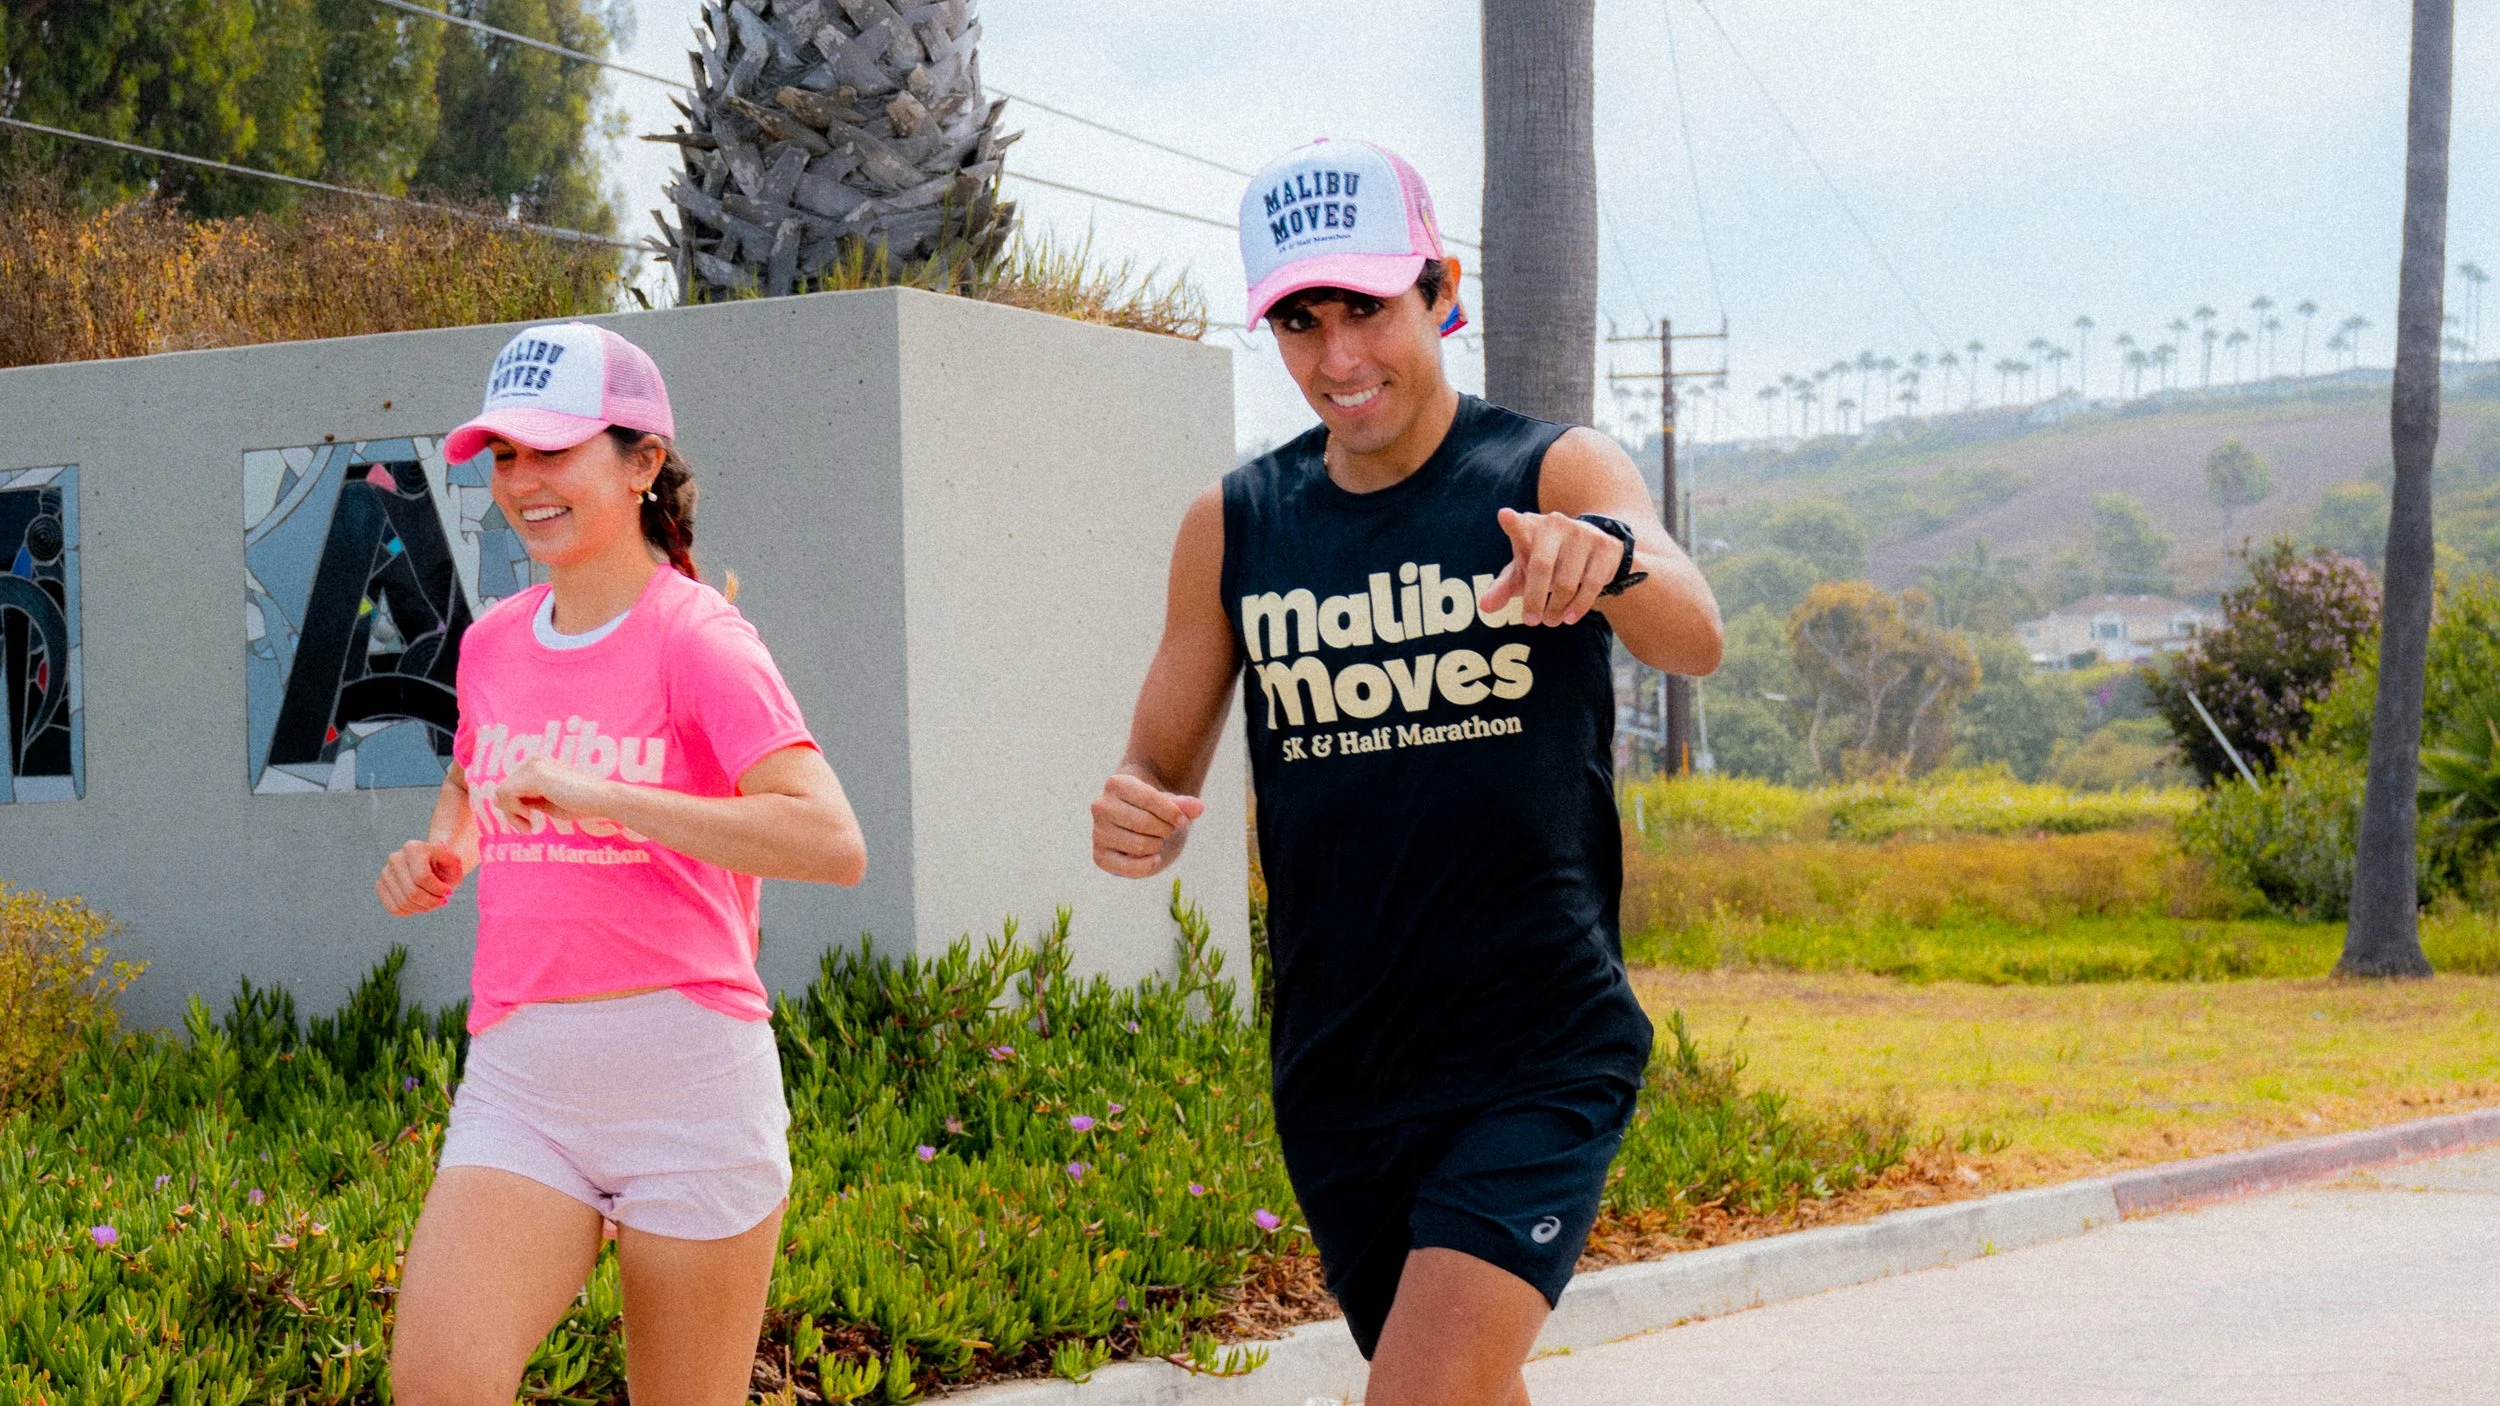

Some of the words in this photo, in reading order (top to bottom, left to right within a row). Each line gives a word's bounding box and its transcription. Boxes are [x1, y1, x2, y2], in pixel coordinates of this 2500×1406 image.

[1263, 169, 1360, 218] MALIBU
[1270, 202, 1358, 246] MOVES
[1254, 643, 1534, 730] moves
[1282, 736, 1308, 762] 5K
[1311, 734, 1333, 758] &
[1336, 726, 1393, 756] Half
[1396, 715, 1523, 749] Marathon
[547, 843, 651, 865] Marathon
